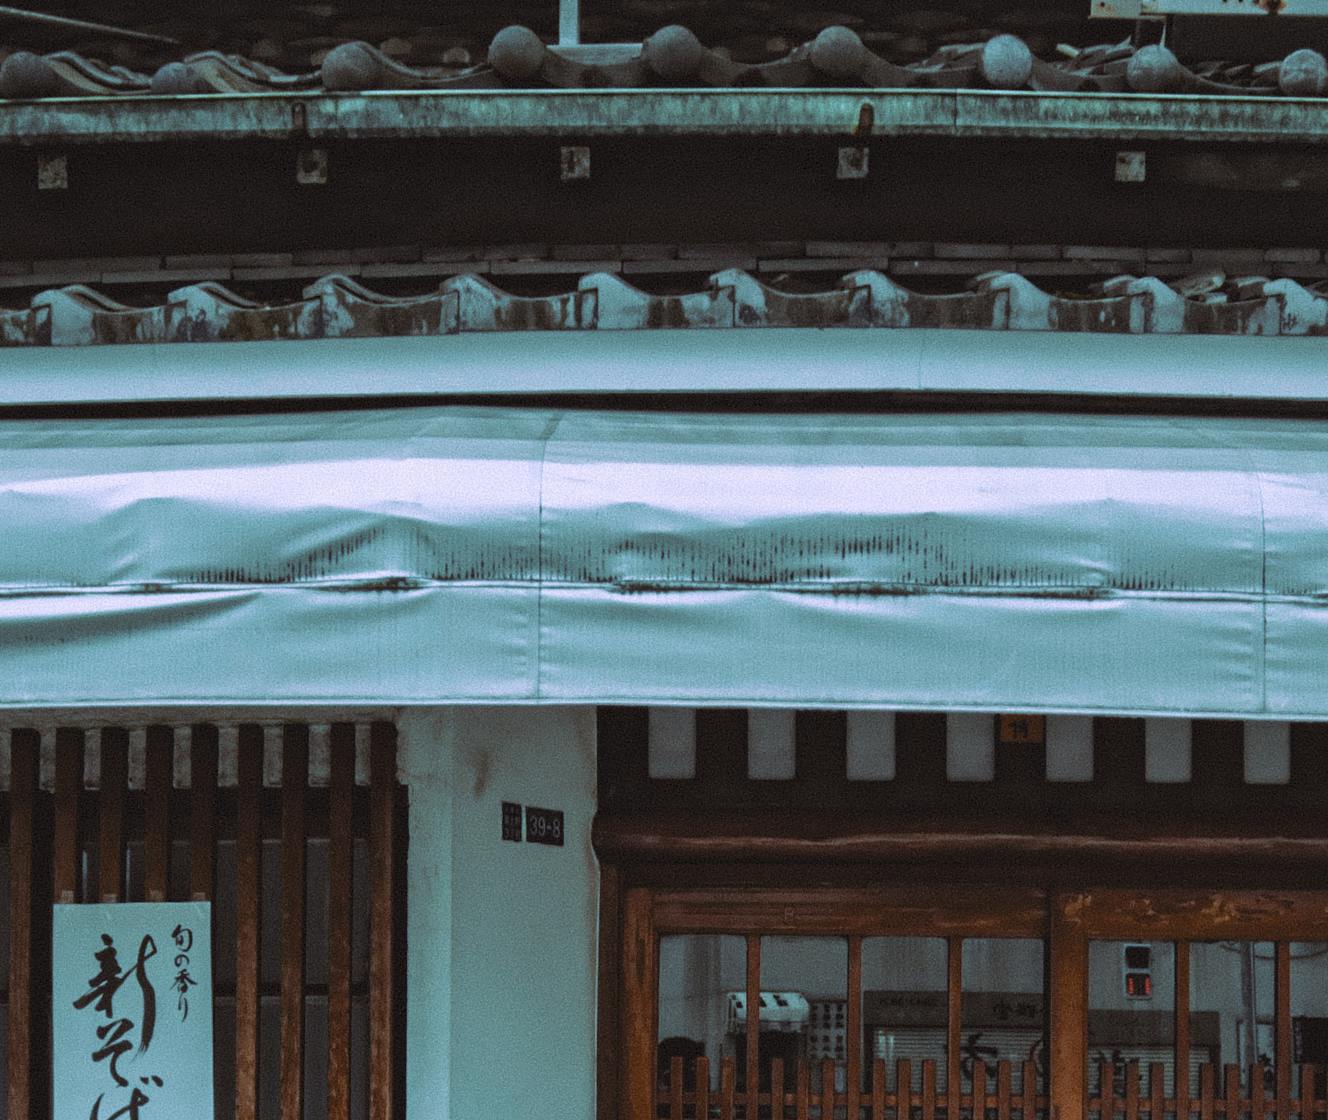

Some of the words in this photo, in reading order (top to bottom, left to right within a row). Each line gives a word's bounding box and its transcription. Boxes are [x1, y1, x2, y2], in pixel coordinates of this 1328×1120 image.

[529, 814, 561, 839] 39-8
[169, 923, 199, 1024] 旬の香り
